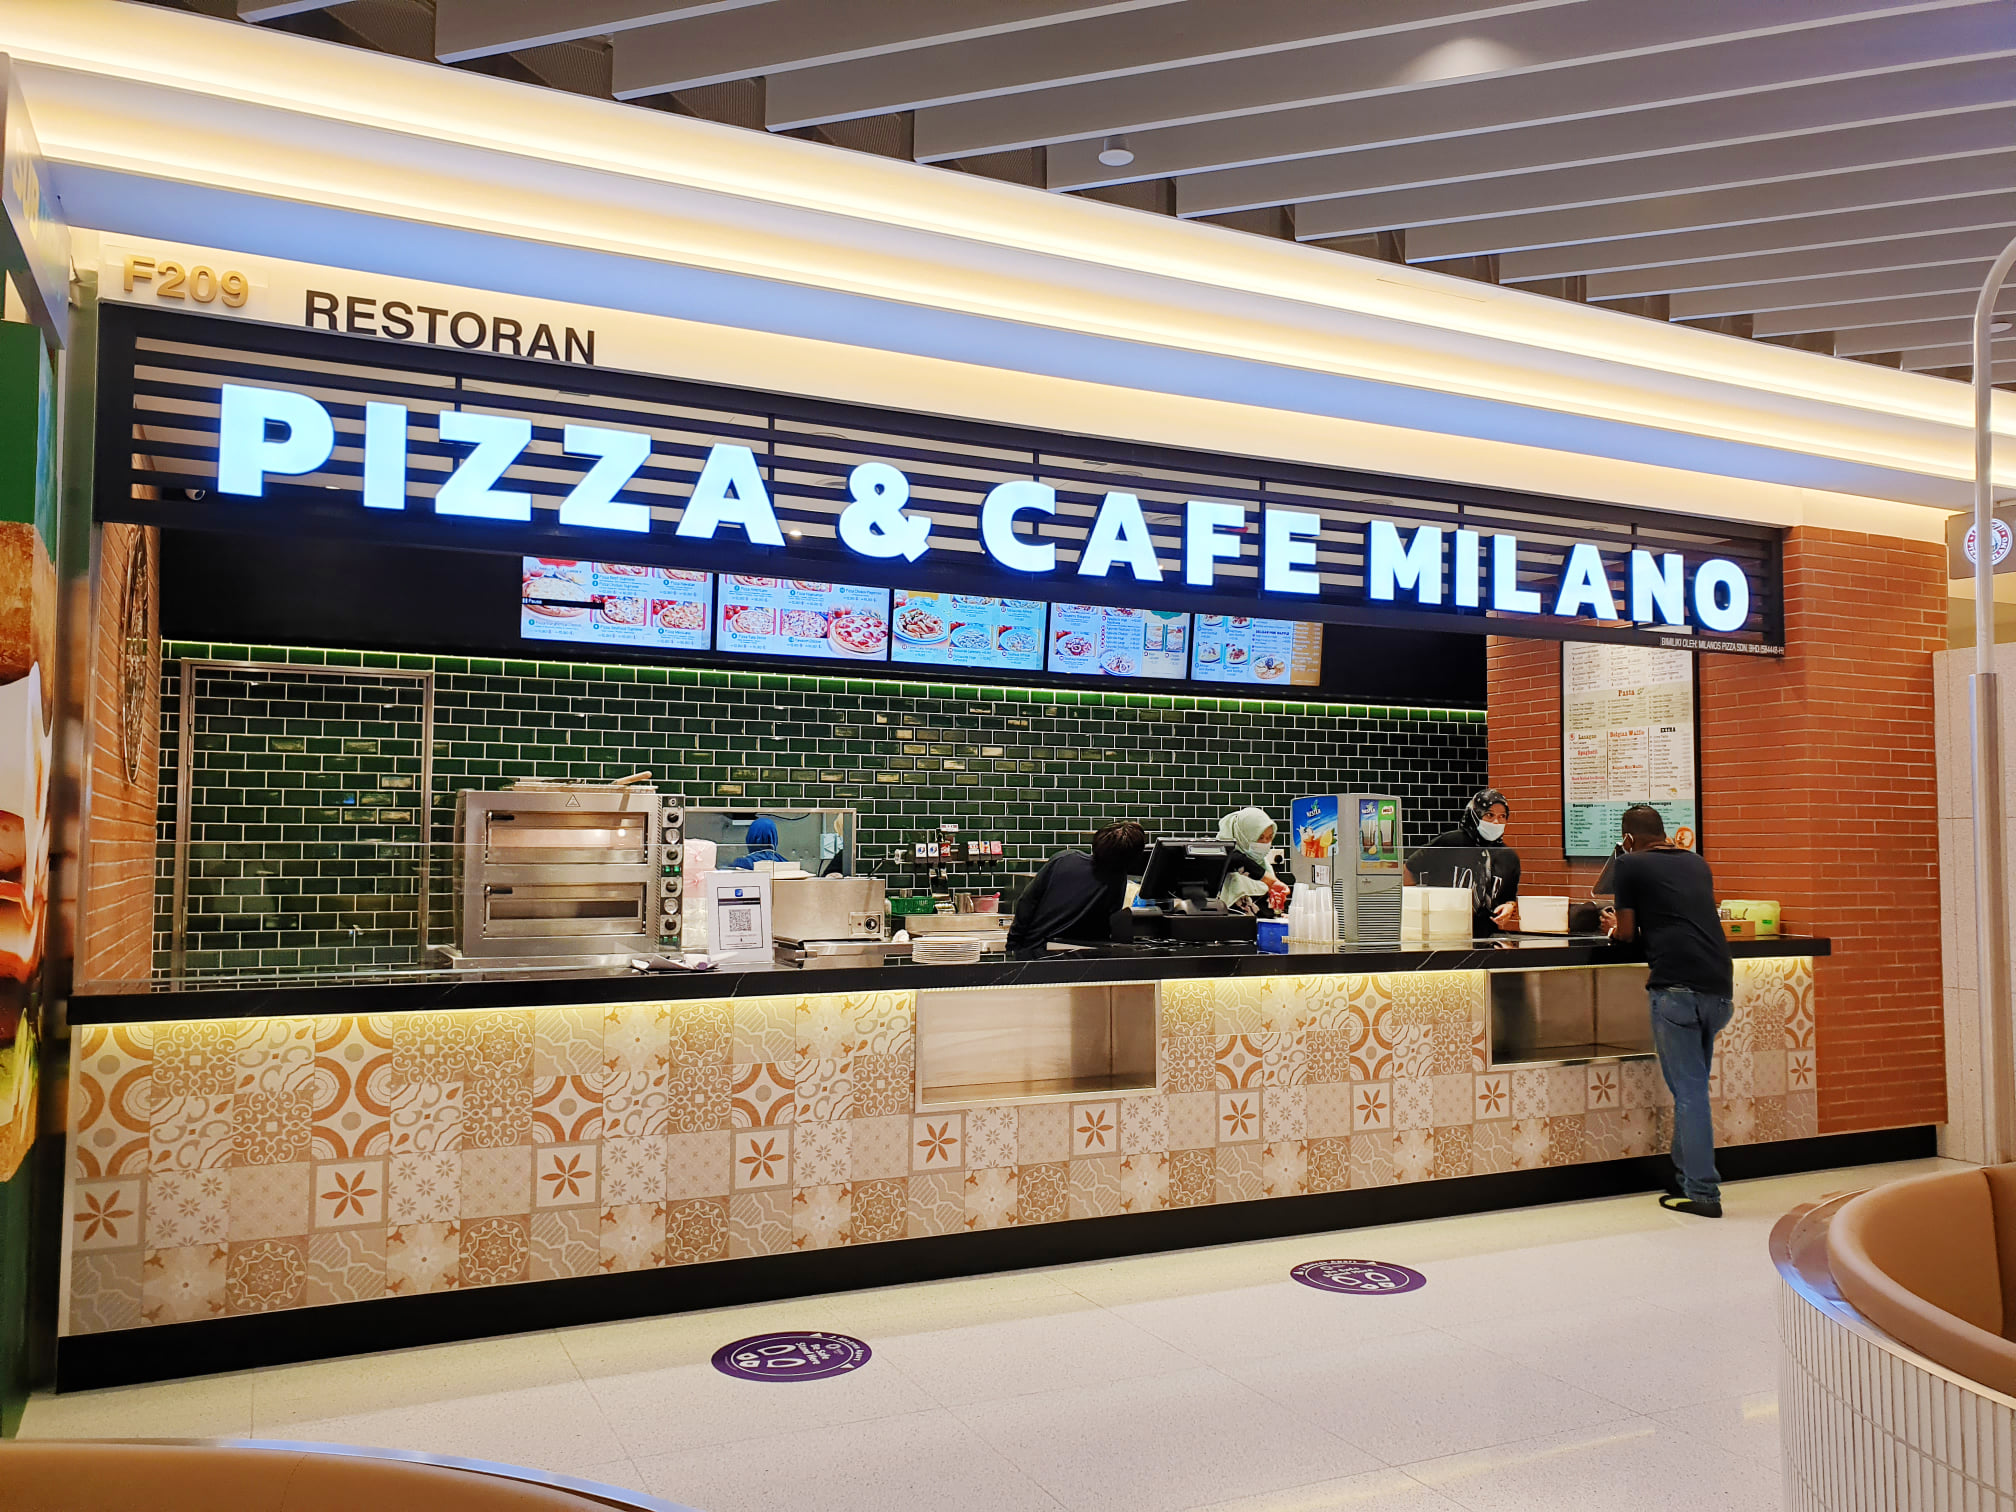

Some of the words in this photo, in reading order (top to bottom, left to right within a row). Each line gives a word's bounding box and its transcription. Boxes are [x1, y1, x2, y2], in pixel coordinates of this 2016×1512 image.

[123, 254, 249, 308] F209
[305, 289, 596, 366] RESTORAN
[216, 382, 787, 548] PIZZA
[838, 462, 933, 564] &
[980, 479, 1323, 597] CAFE
[1368, 519, 1751, 632] MILANO
[1618, 689, 1635, 697] Pasta
